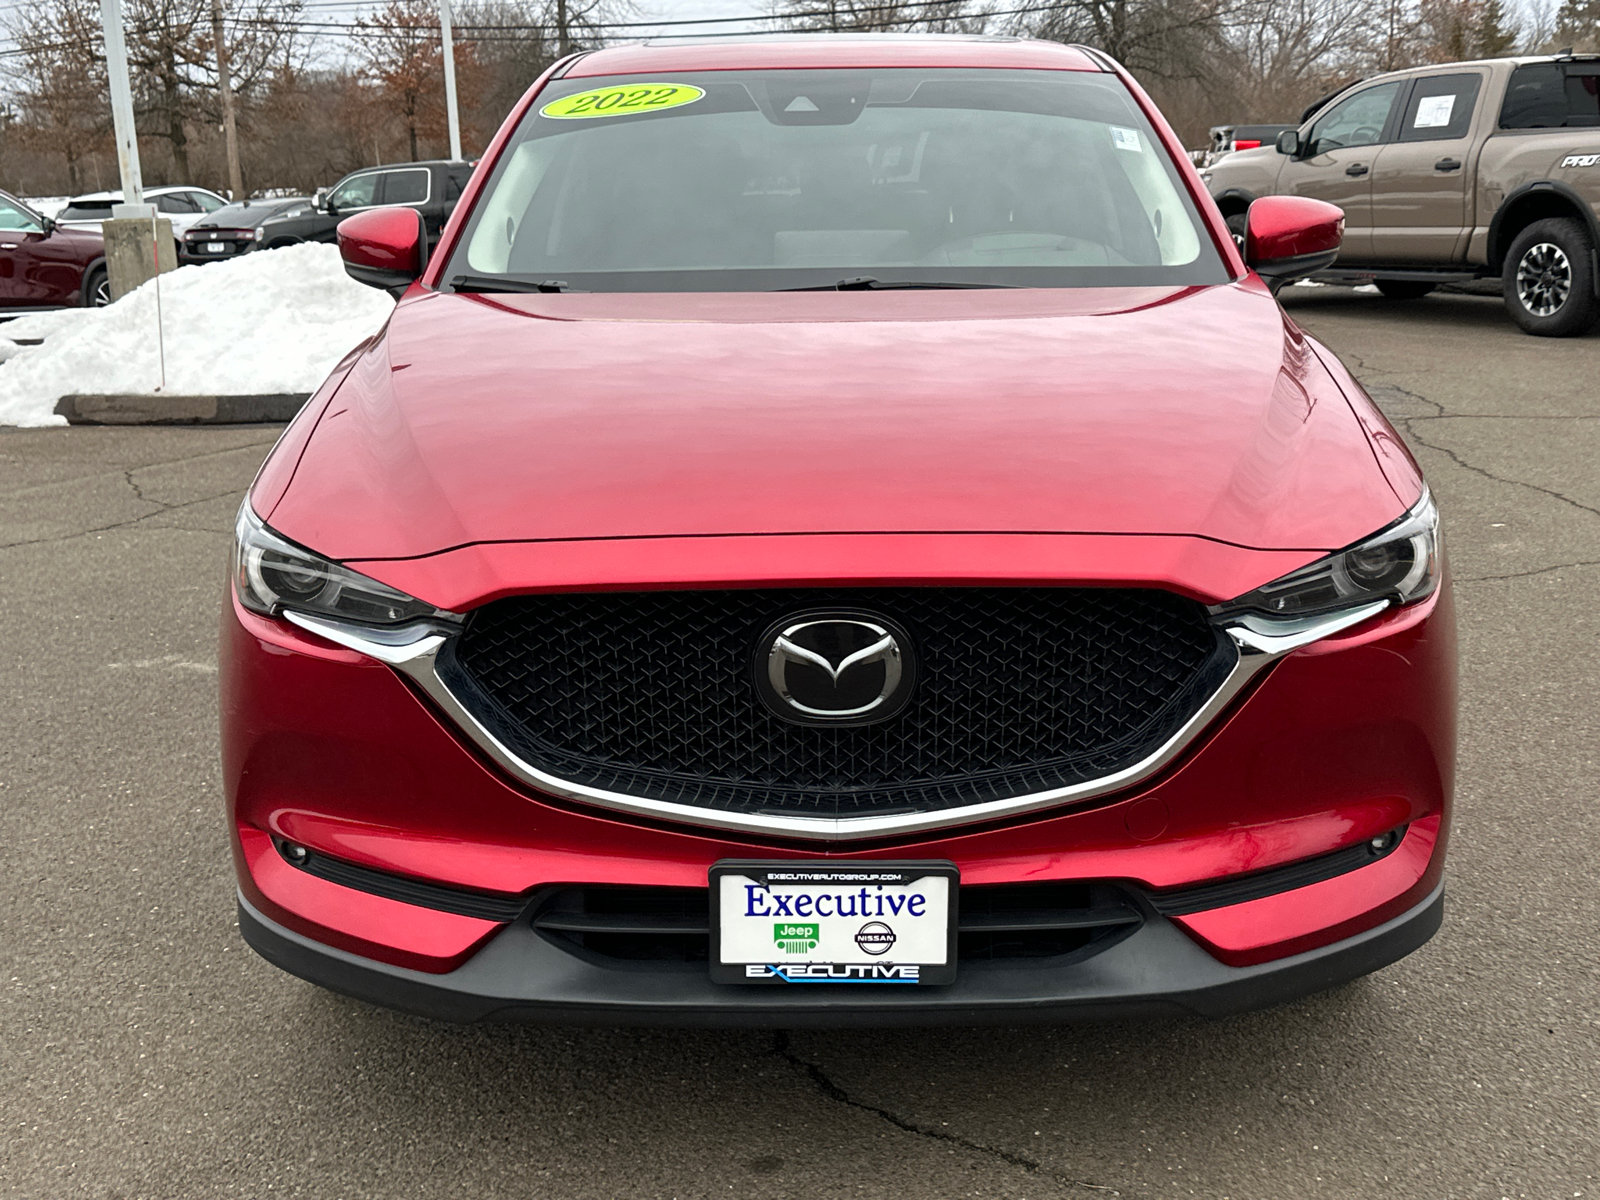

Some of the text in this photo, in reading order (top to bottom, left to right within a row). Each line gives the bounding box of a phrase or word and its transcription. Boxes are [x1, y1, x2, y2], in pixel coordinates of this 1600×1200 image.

[564, 87, 679, 115] 2022
[1560, 154, 1600, 168] PRO
[767, 873, 902, 881] EXECUTIVEAUTOGROUP.COM
[744, 884, 926, 917] Executive
[780, 925, 813, 938] Jeep
[857, 934, 894, 943] NISSAN
[745, 964, 920, 979] EXECUTIVE
